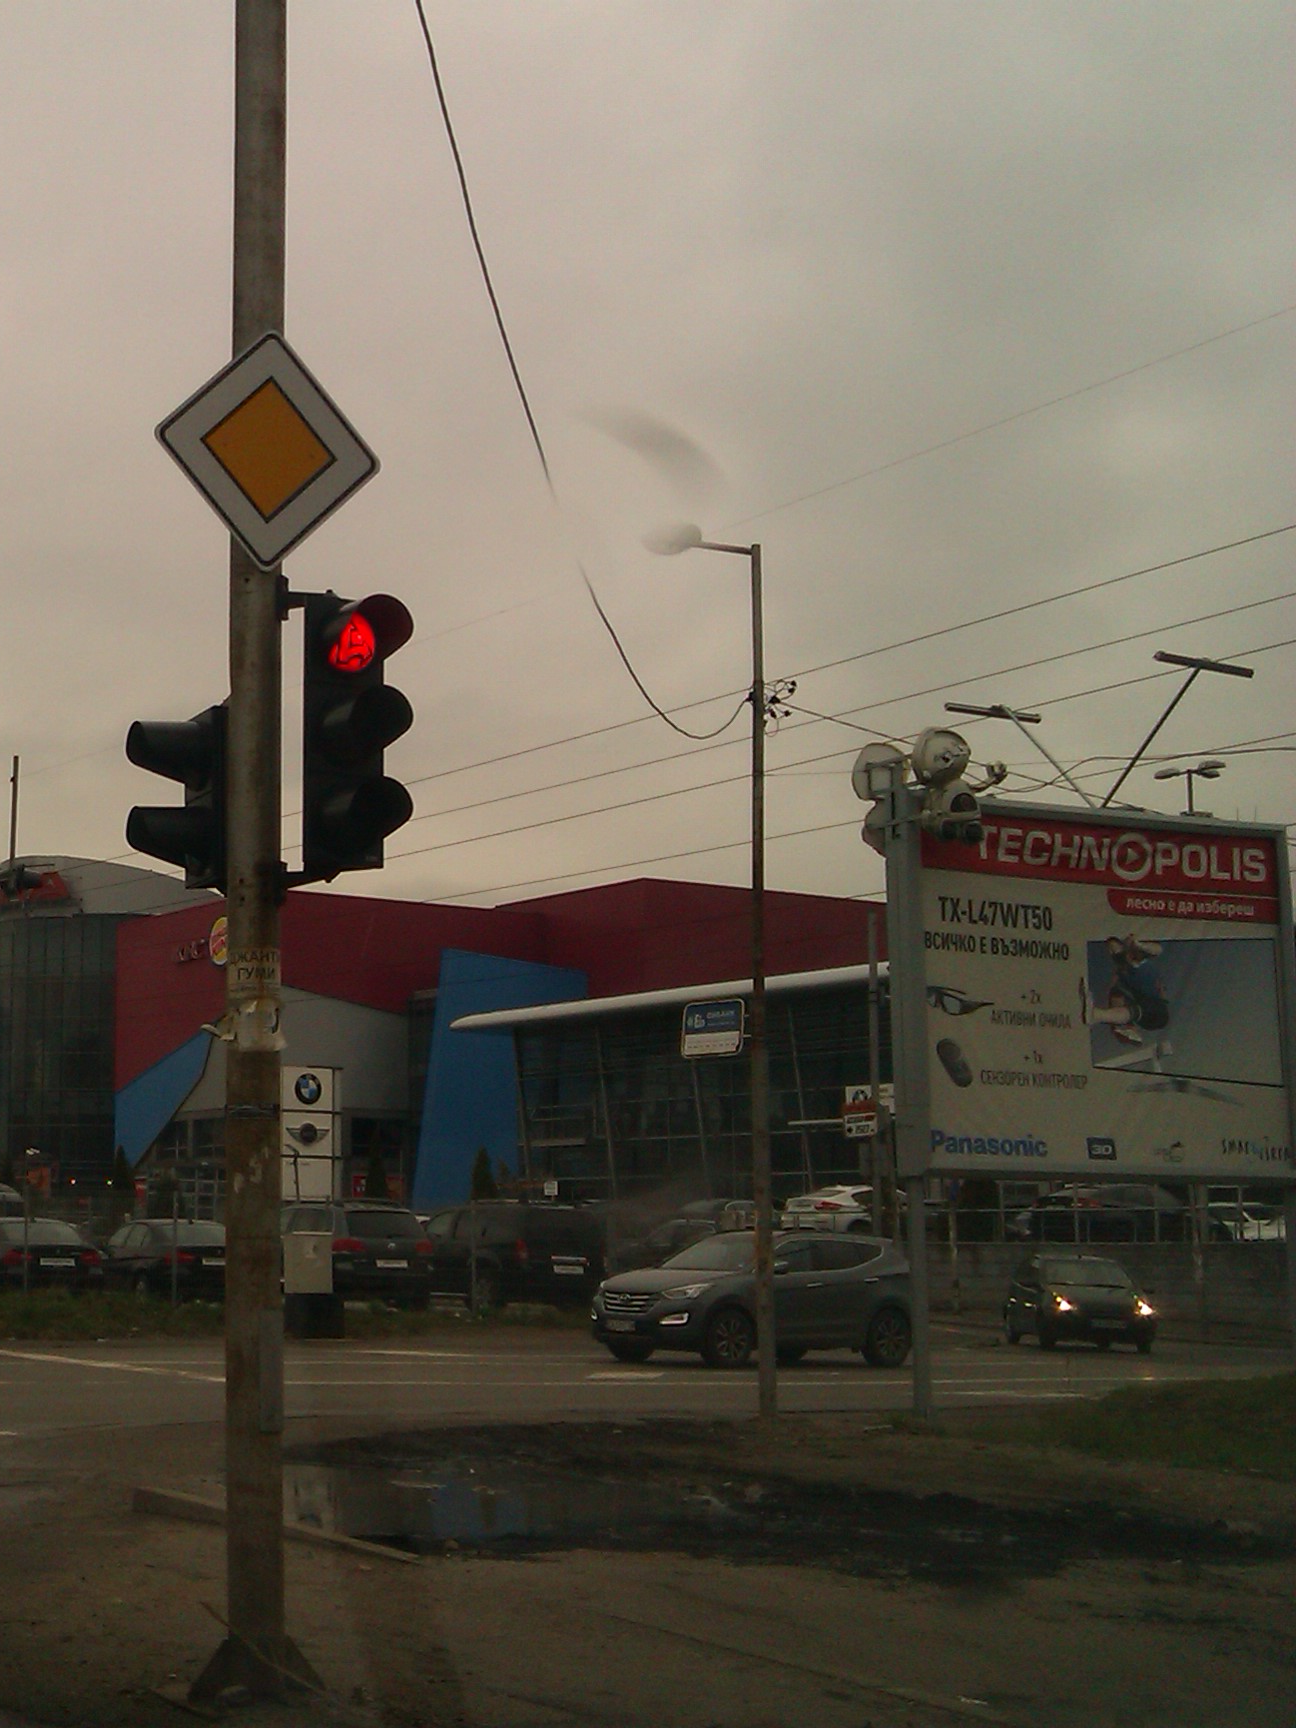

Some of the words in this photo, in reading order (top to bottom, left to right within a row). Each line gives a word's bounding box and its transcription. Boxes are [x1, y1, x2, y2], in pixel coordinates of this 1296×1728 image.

[937, 896, 1053, 931] TX-L47WT50
[1126, 897, 1166, 912] лесно
[1177, 900, 1195, 915] да
[1195, 899, 1255, 919] избереш
[923, 930, 976, 953] ВСИЧКО
[979, 937, 987, 954] Е
[990, 937, 1070, 961] ВЪЗМОЖНО
[990, 1010, 1036, 1027] АКТИВНИ
[980, 1069, 1030, 1087] СЕНЗОРЕН
[930, 1129, 1049, 1158] Panasonic
[1090, 1144, 1112, 1155] 3D
